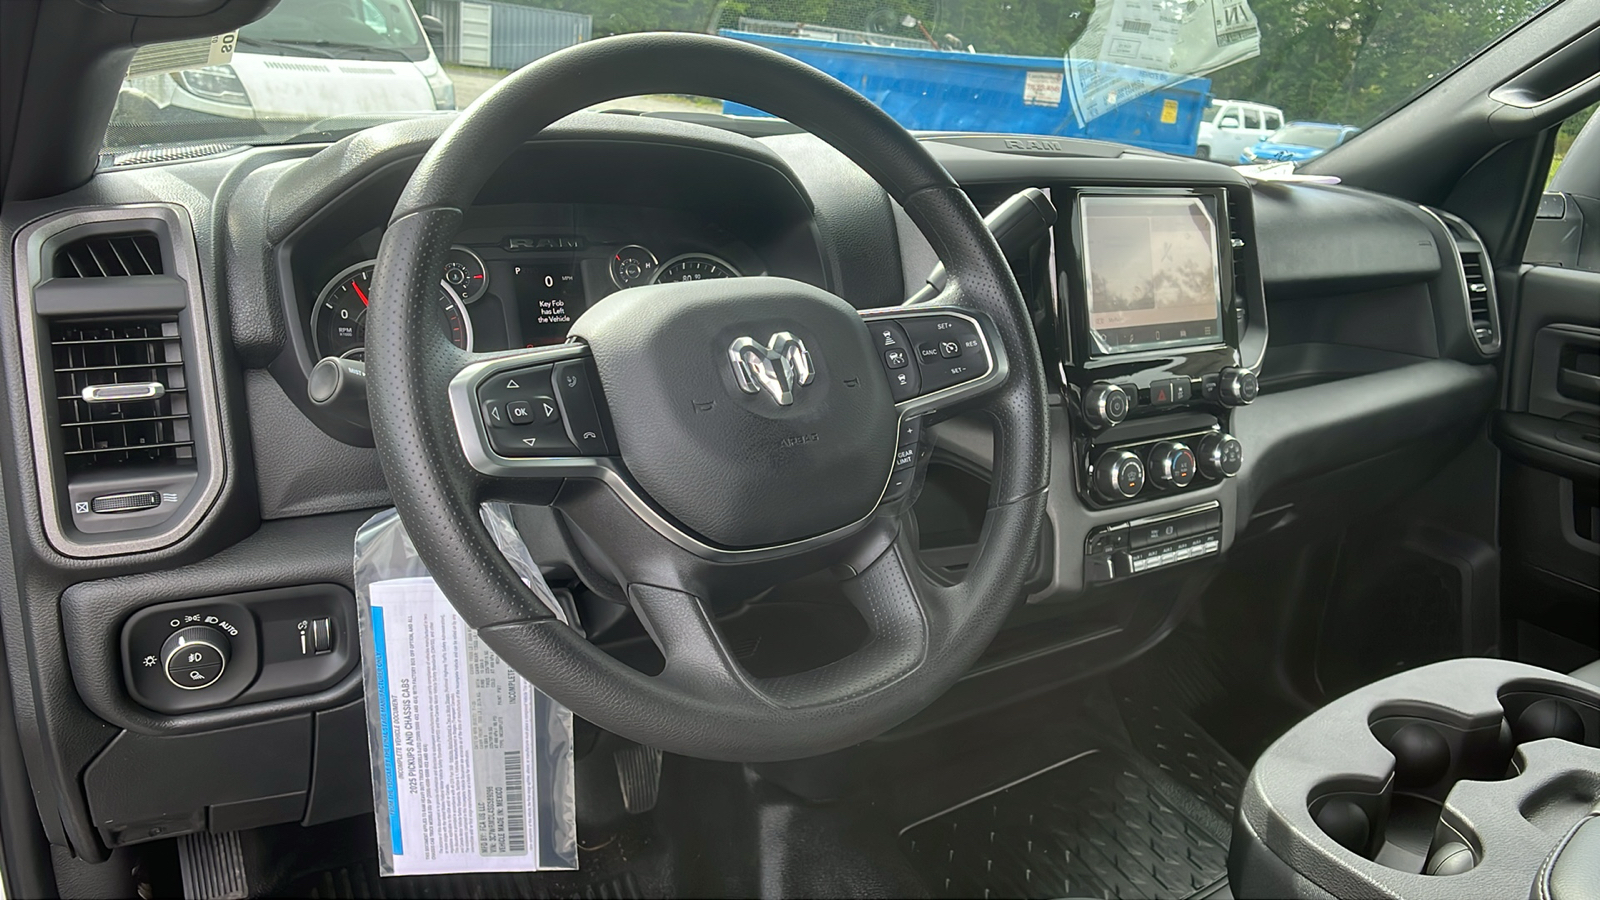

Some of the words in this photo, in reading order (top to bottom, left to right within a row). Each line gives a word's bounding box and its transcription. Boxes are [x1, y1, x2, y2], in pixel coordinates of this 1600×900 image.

[1004, 140, 1062, 151] RAM
[509, 239, 579, 248] RAM
[514, 266, 520, 274] P
[544, 276, 554, 288] 0
[539, 300, 551, 308] Key
[340, 309, 348, 320] 0
[514, 408, 528, 416] OK
[896, 456, 912, 464] LIMIT
[898, 450, 914, 458] GEAR
[218, 620, 238, 636] AUTO
[400, 678, 410, 698] CABS
[506, 668, 517, 704] INCOMPLETE
[391, 694, 399, 724] DOCUMENT
[402, 698, 412, 730] CHASSIS
[404, 730, 414, 746] AND
[395, 746, 404, 779] INCOMPLETE
[406, 746, 416, 776] PICKUPS
[408, 777, 418, 794] 2025
[494, 786, 503, 807] MEXICO
[478, 812, 486, 820] US
[496, 816, 505, 831] MADE
[498, 833, 506, 852] VEHICLE
